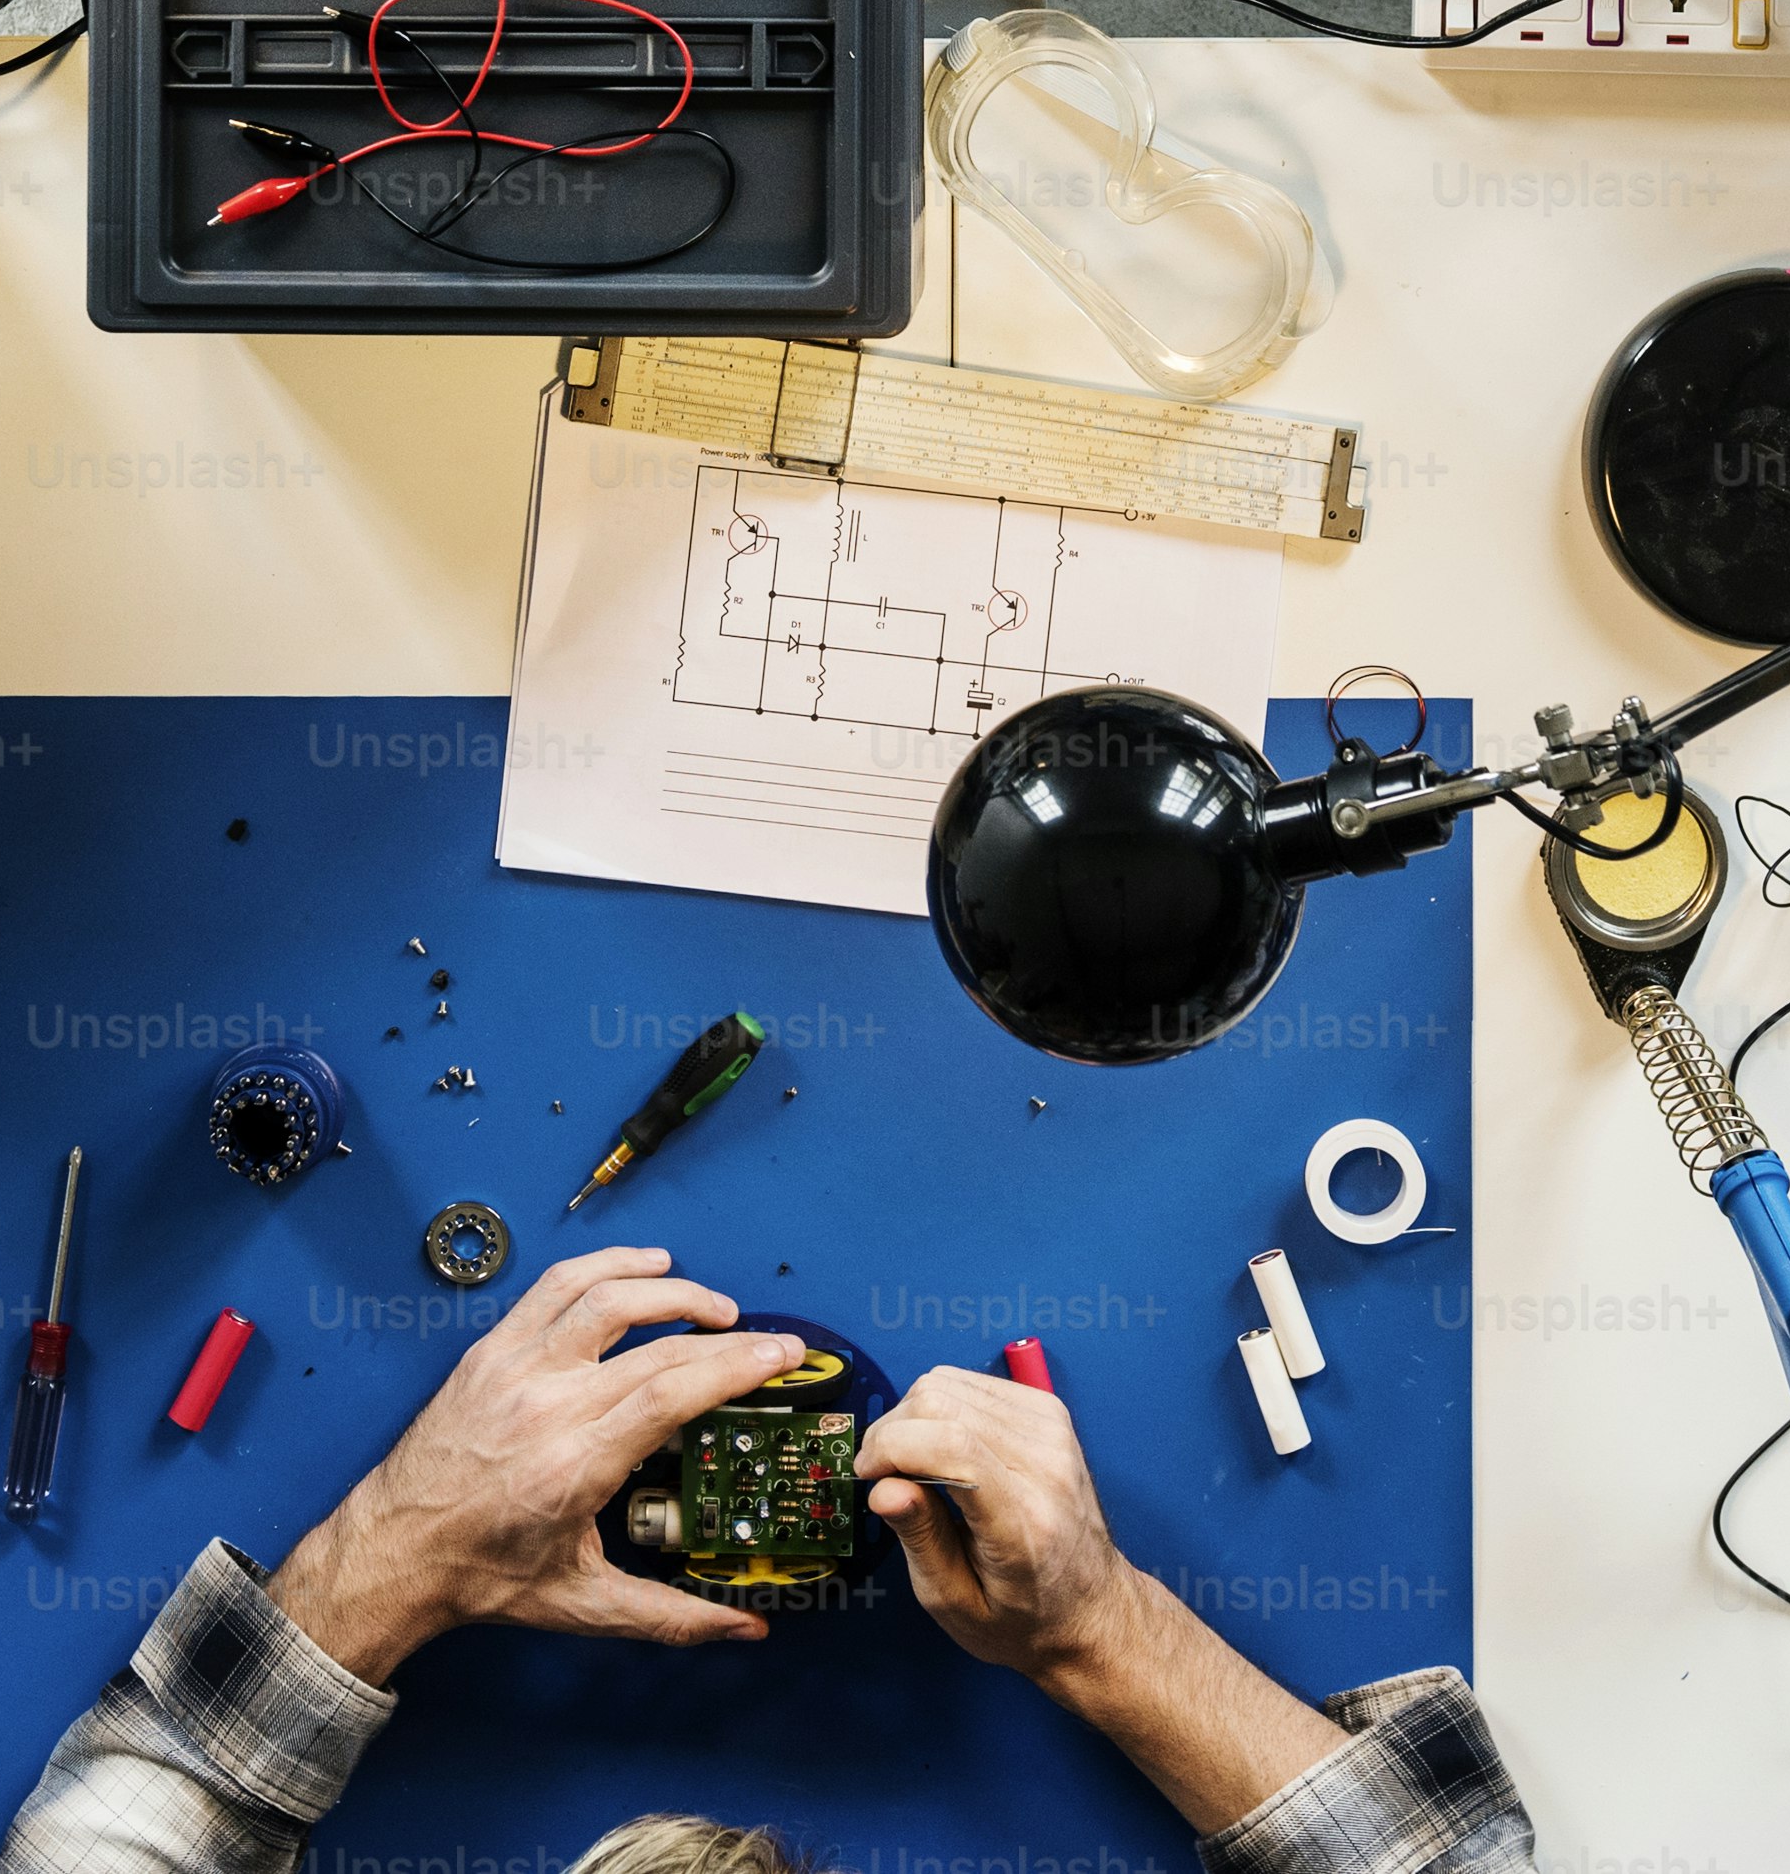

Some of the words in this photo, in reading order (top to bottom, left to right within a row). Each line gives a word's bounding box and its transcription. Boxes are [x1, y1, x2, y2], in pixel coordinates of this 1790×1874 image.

[701, 448, 723, 456] Power
[726, 452, 750, 461] supply
[712, 528, 724, 536] TR1
[972, 604, 985, 612] TR2
[1122, 678, 1144, 687] +OUT
